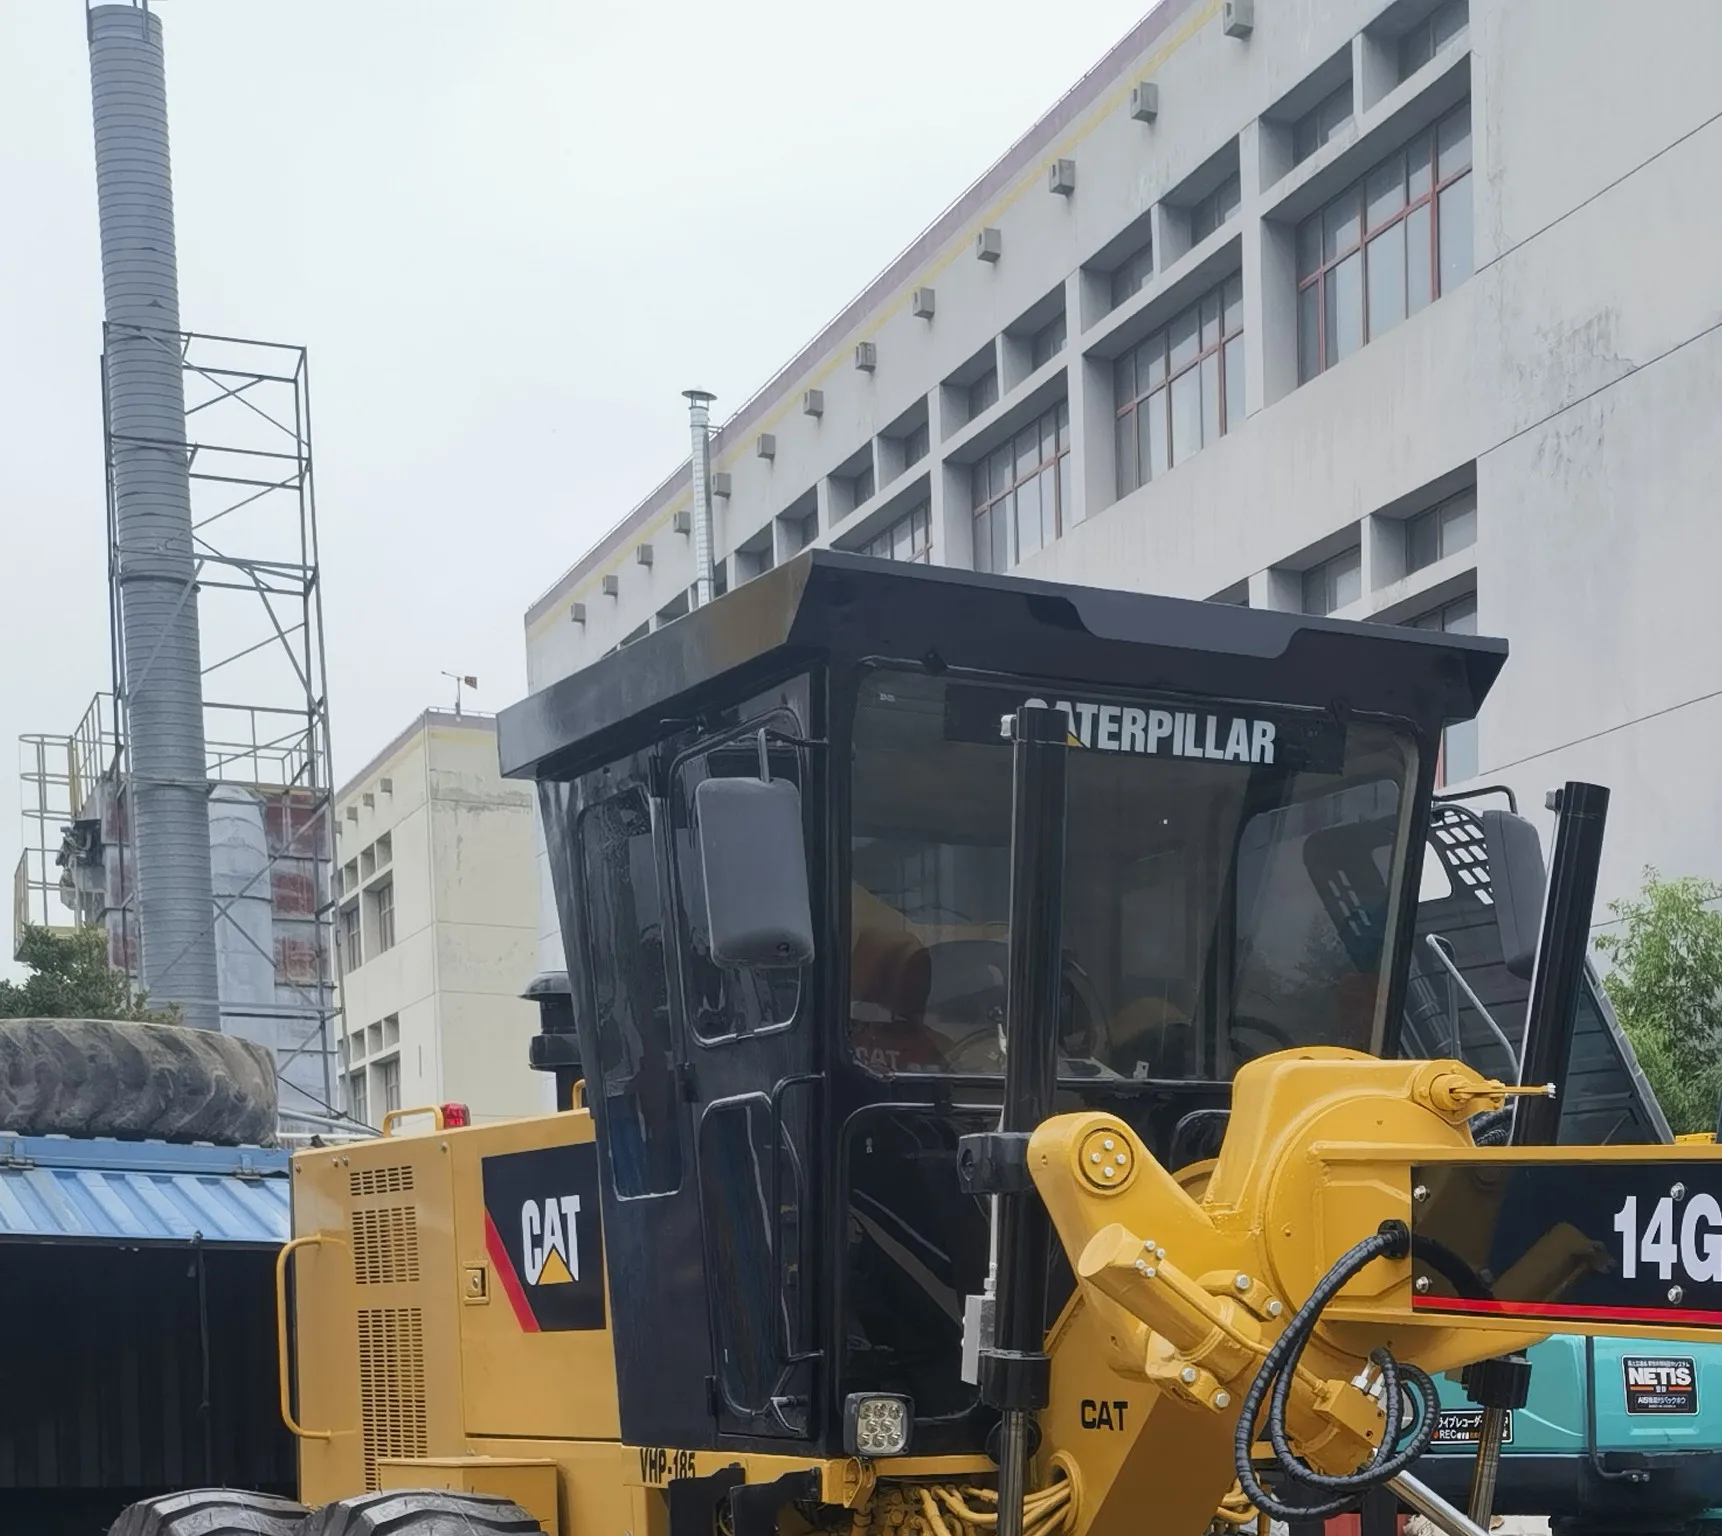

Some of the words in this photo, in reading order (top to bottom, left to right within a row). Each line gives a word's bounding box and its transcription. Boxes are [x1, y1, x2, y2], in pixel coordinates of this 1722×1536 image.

[1024, 698, 1275, 764] ATERPILLAR
[521, 1194, 581, 1286] CAT
[1628, 1367, 1692, 1385] NETIS
[1081, 1399, 1128, 1431] CAT
[640, 1447, 697, 1484] VHP-185
